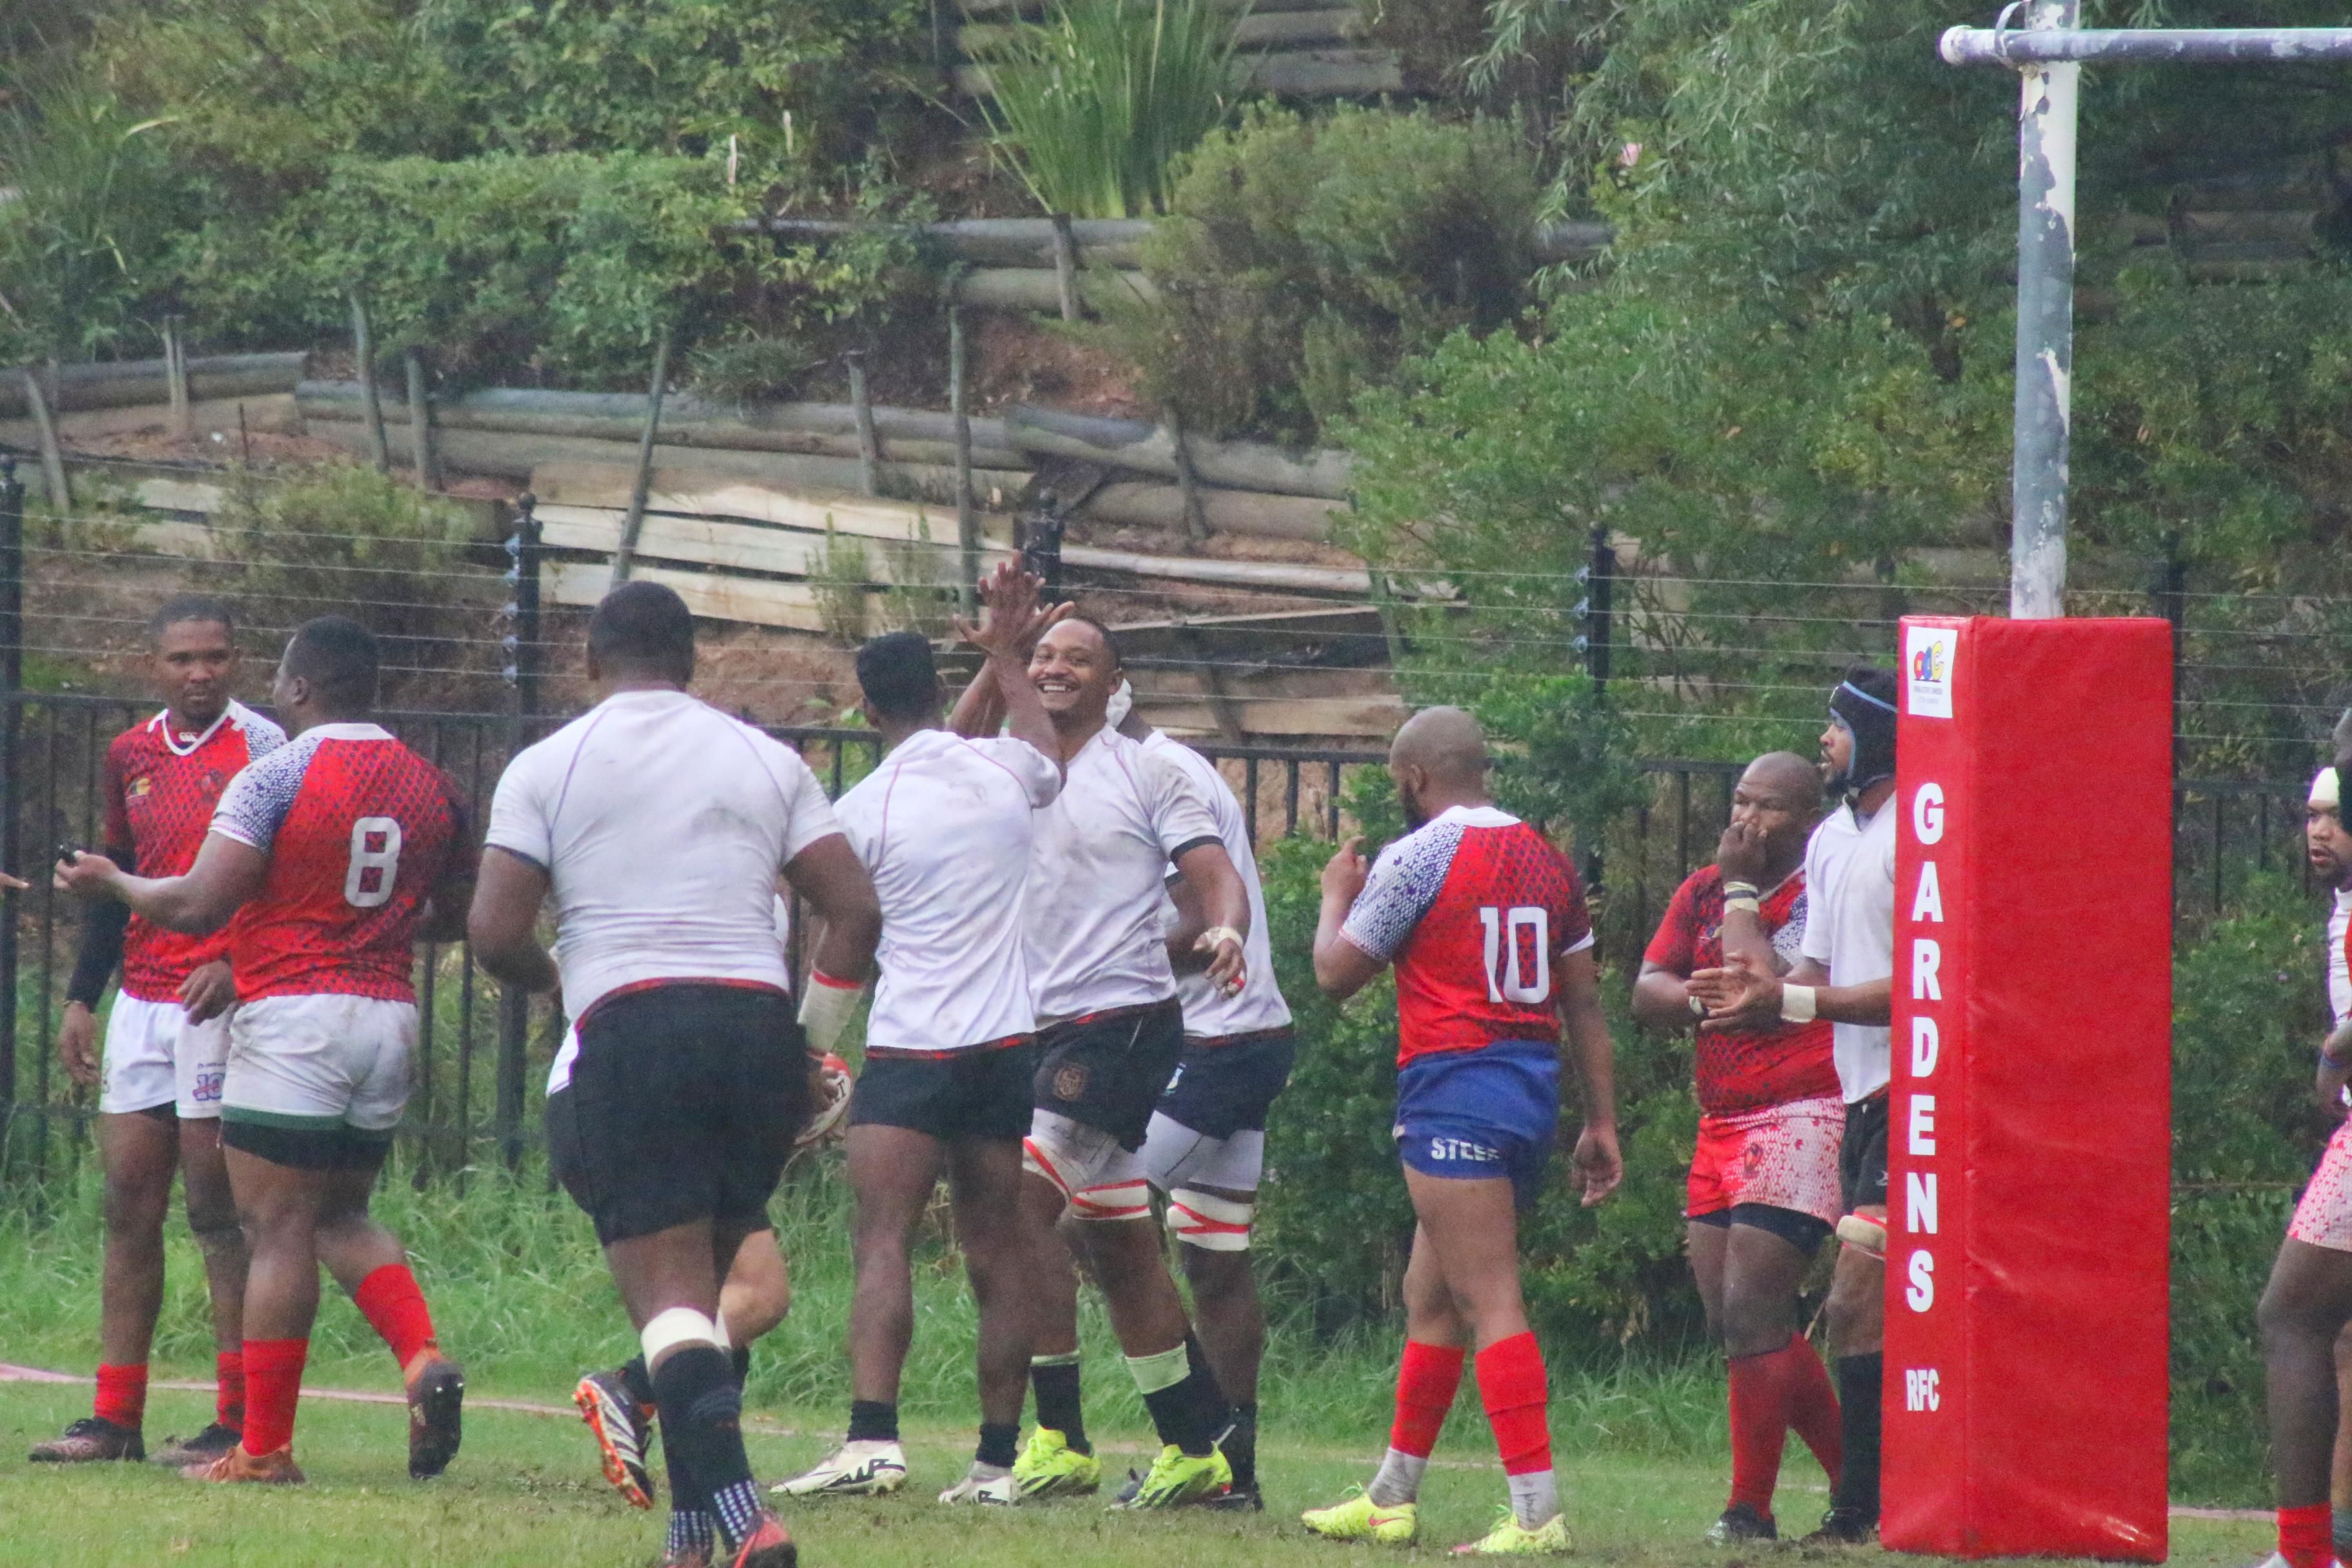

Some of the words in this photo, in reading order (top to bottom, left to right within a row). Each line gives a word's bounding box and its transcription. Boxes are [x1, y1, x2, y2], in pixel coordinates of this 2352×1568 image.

[344, 817, 401, 906] 8
[1480, 906, 1550, 1003] 10
[1906, 782, 1945, 1313] GARDENS
[1906, 1369, 1940, 1412] RFC
